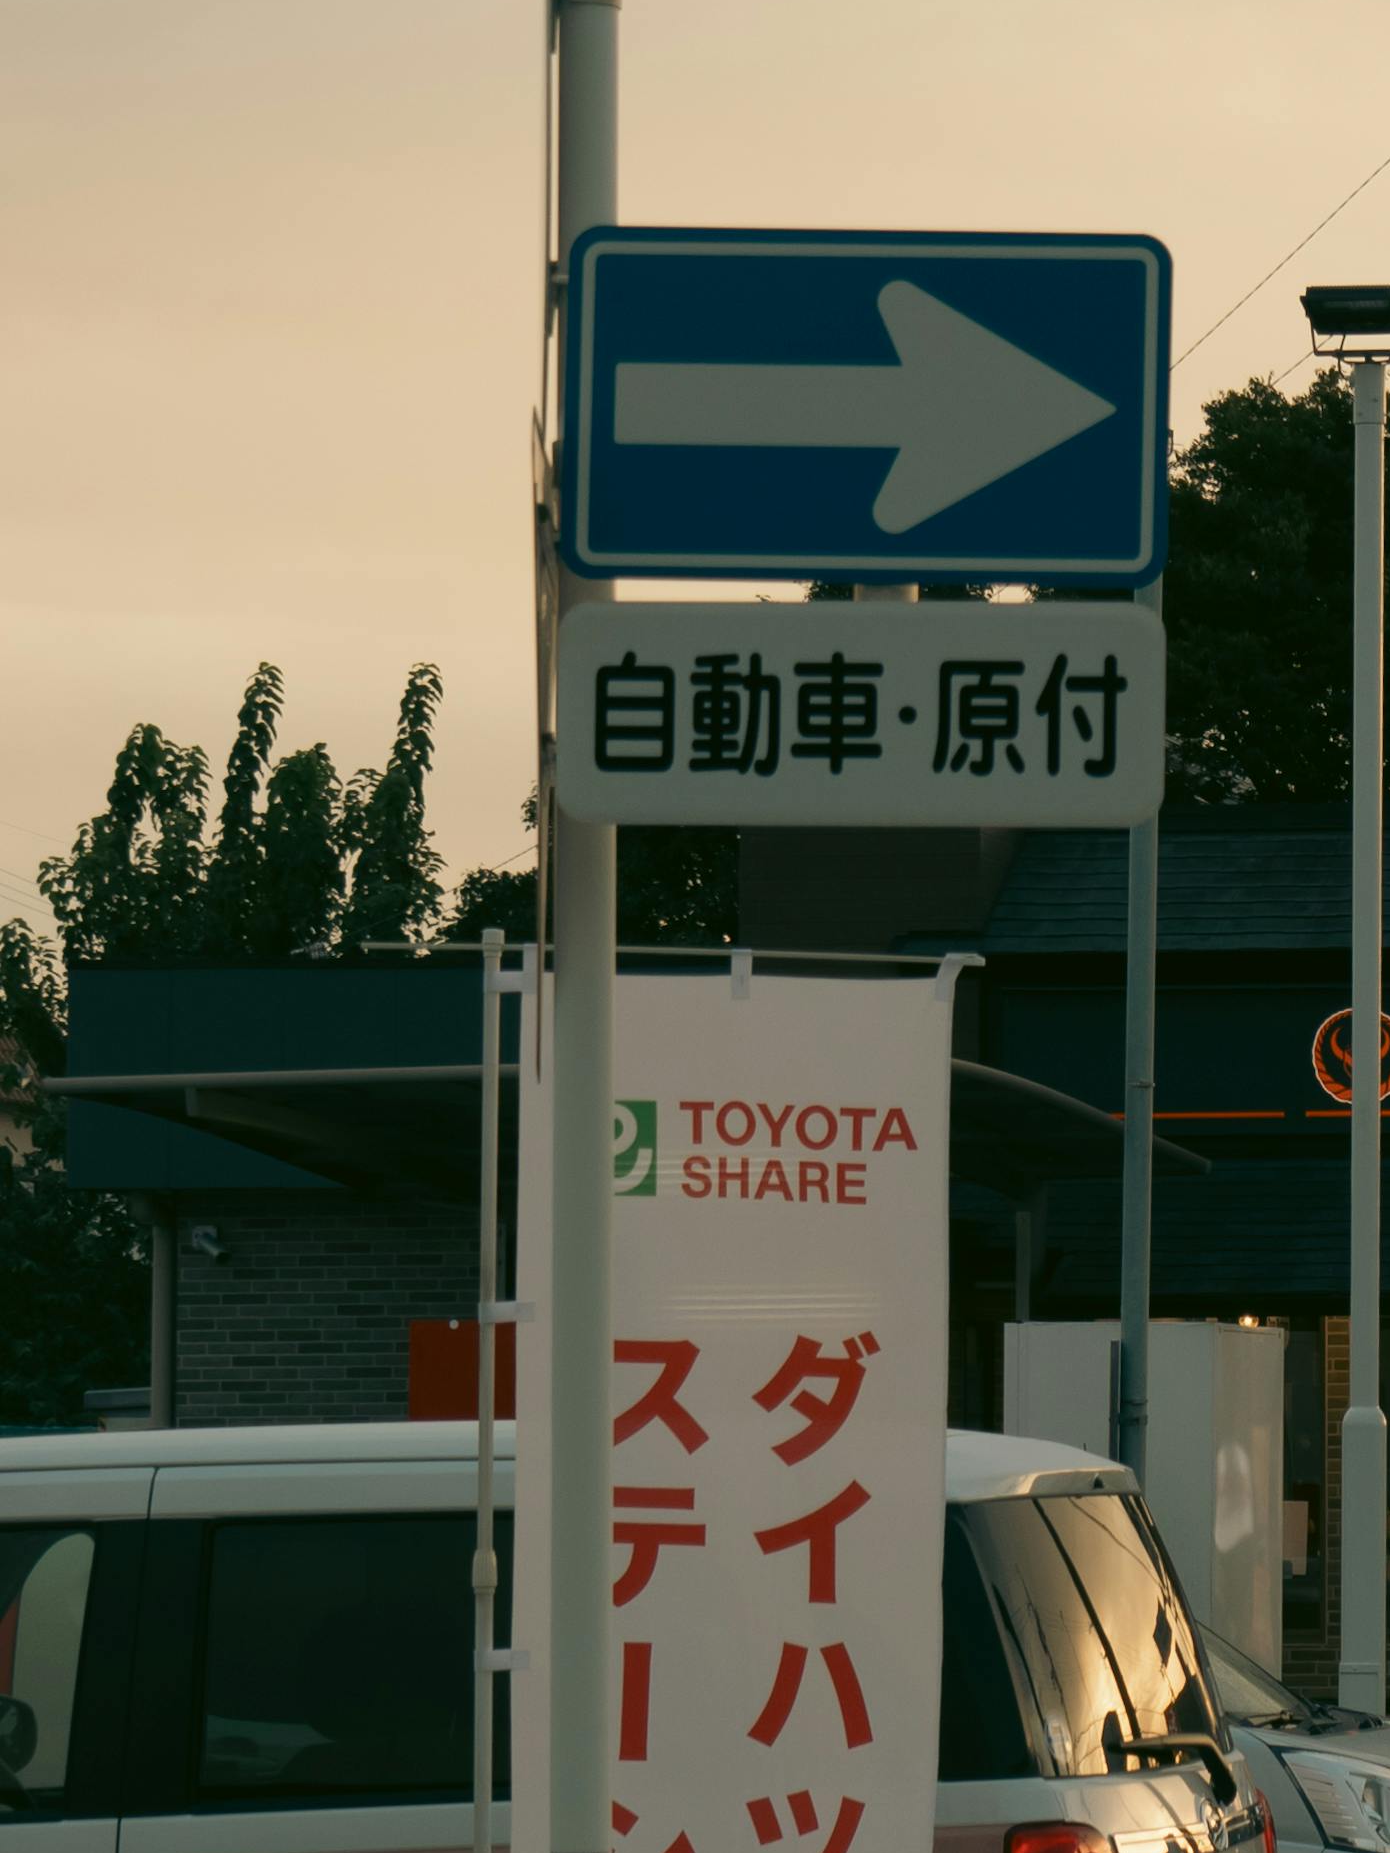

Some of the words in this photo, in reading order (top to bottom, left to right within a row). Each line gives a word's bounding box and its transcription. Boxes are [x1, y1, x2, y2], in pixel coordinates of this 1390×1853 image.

[594, 650, 1128, 778] 自動車・原付
[679, 1100, 918, 1152] TOYOTA
[681, 1156, 868, 1205] SHARE
